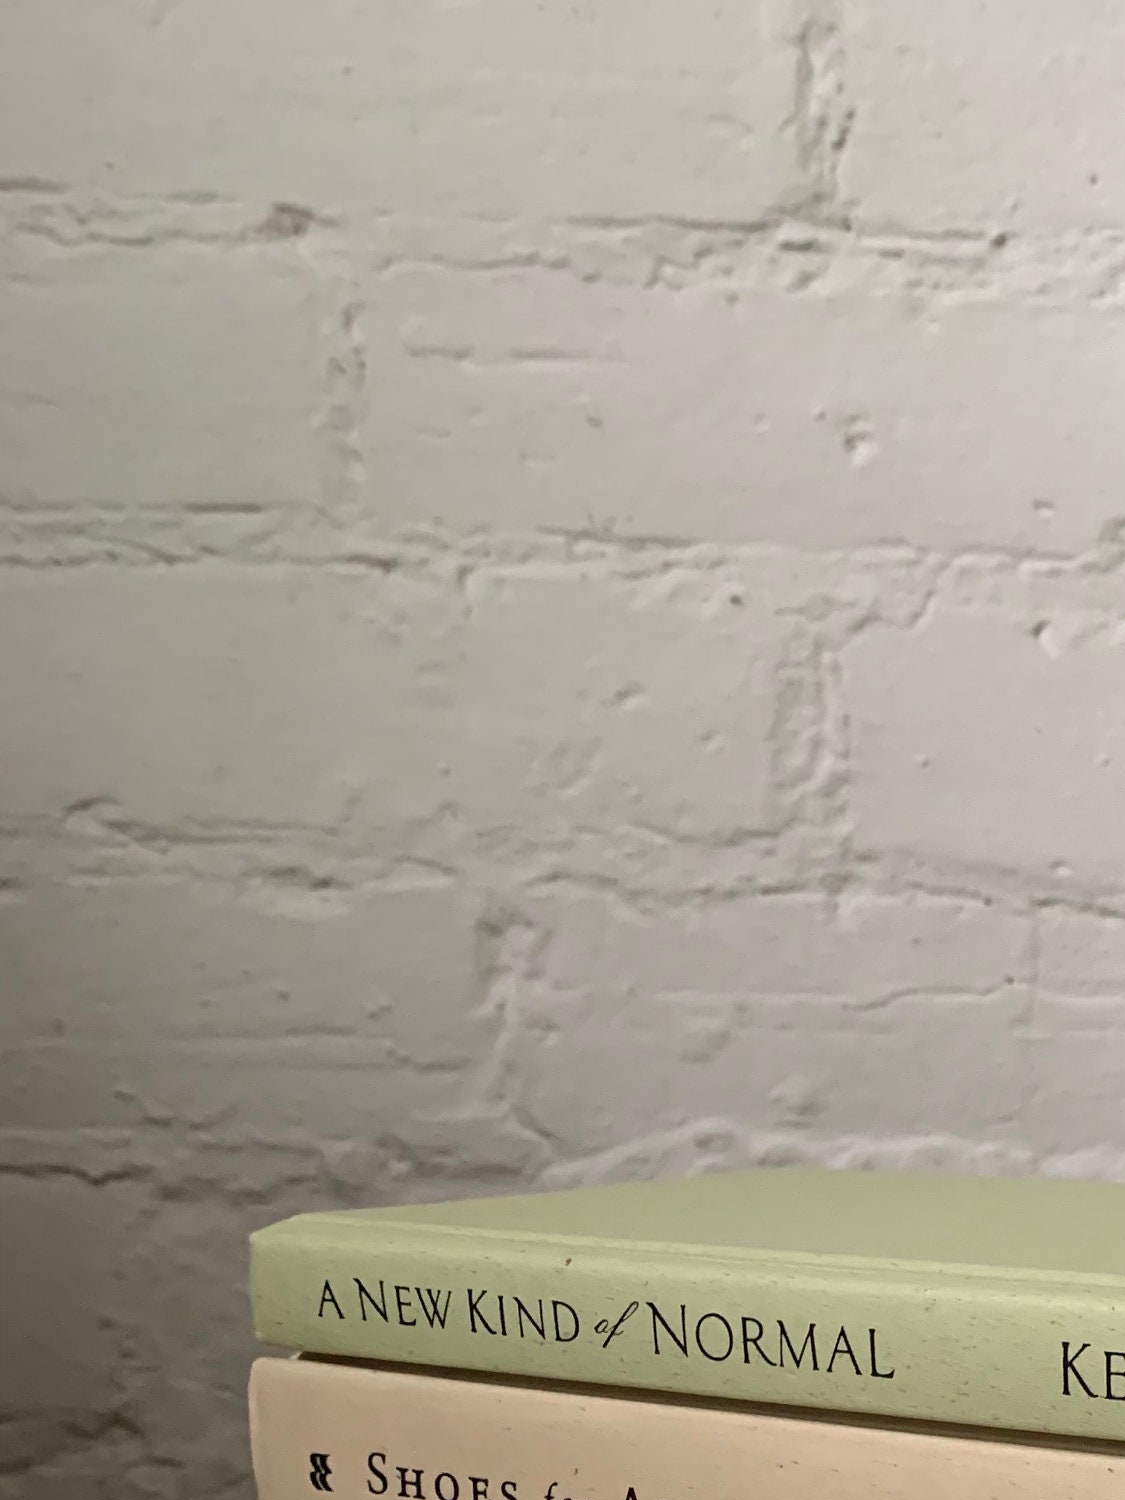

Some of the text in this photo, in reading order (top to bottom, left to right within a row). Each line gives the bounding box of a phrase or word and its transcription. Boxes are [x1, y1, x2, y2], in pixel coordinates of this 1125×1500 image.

[318, 1277, 895, 1379] A NEW KIND of NORMAL
